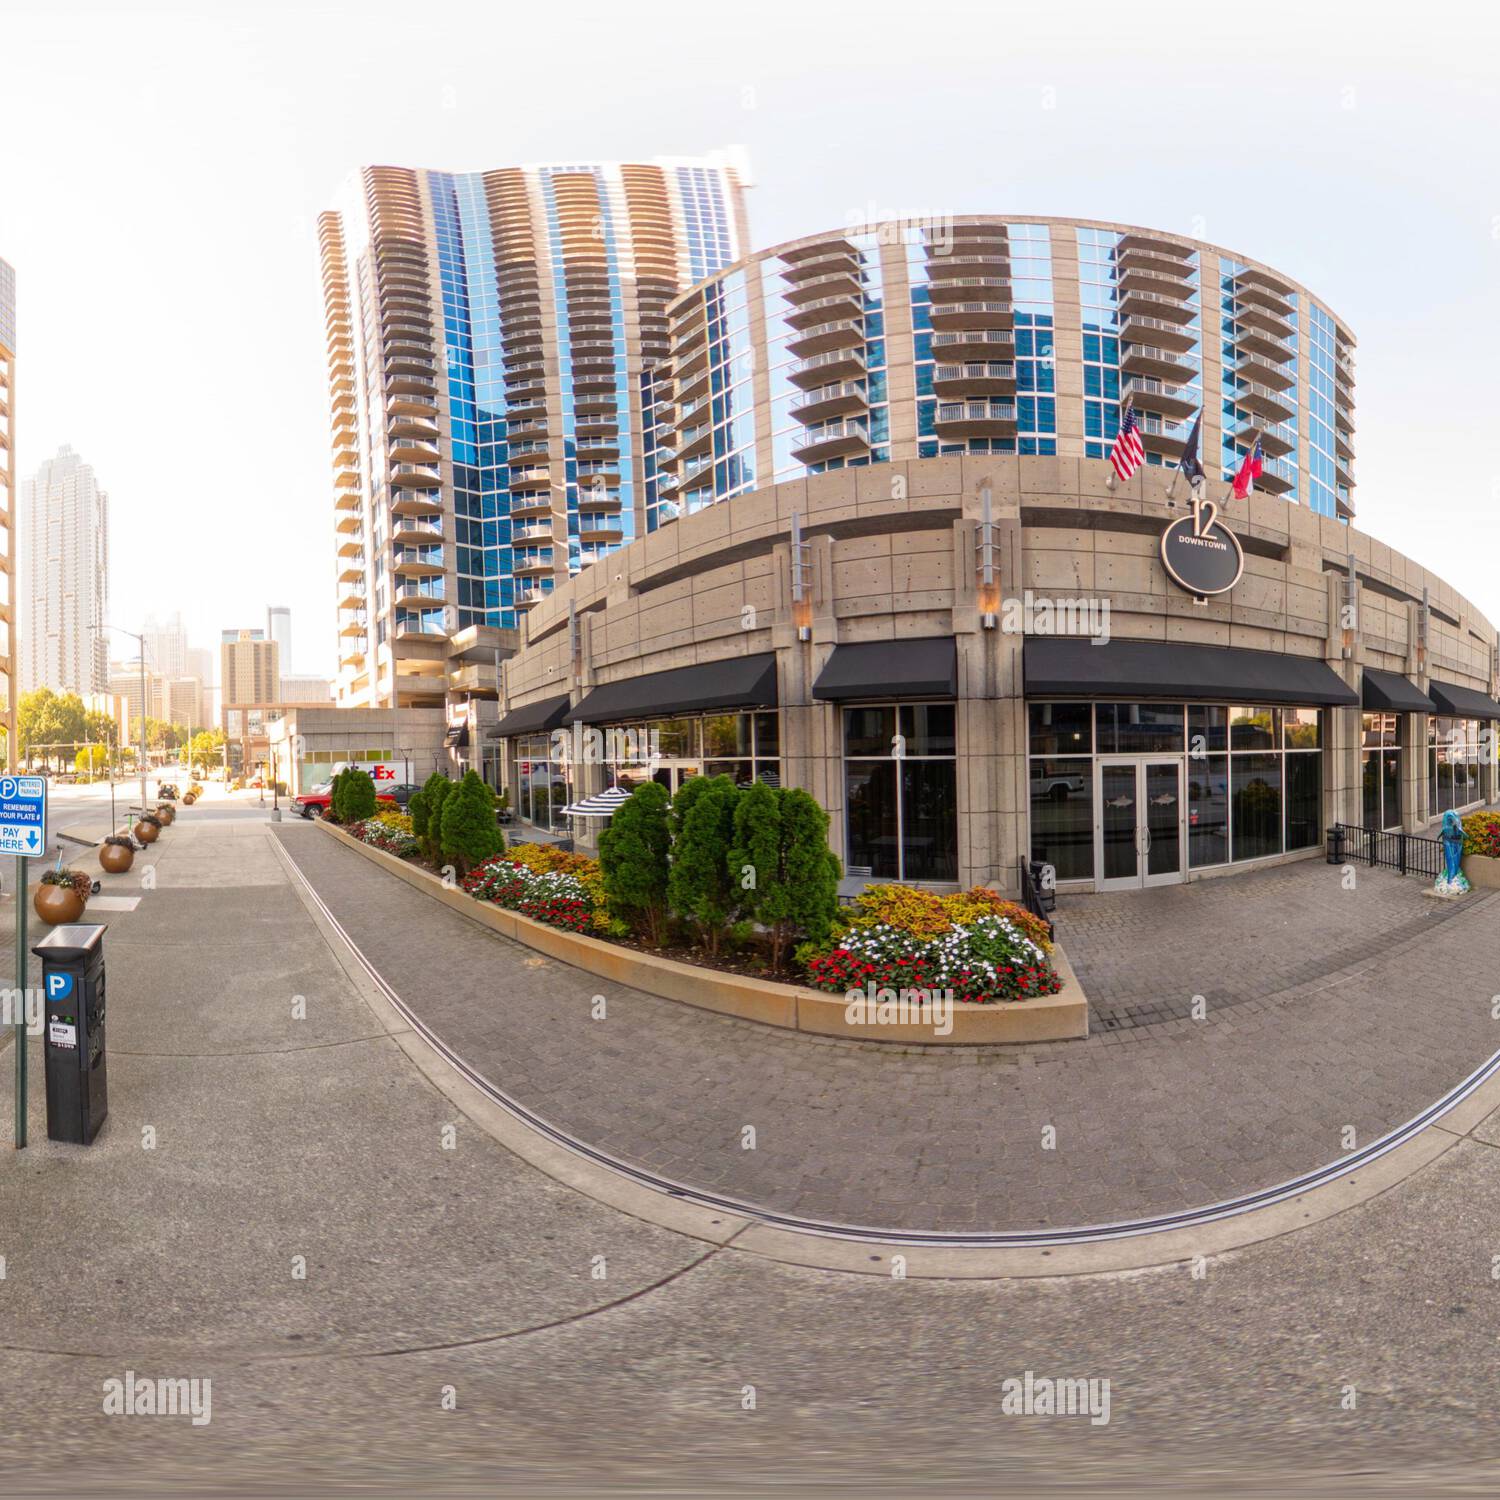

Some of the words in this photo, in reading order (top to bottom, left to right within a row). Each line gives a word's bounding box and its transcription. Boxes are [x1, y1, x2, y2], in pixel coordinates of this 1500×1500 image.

[1191, 497, 1218, 540] 12
[1178, 535, 1227, 551] DOWNTOWN
[3, 803, 37, 812] REMEMBER
[17, 812, 35, 821] PLATE
[3, 827, 20, 838] PAY
[49, 975, 66, 996] P
